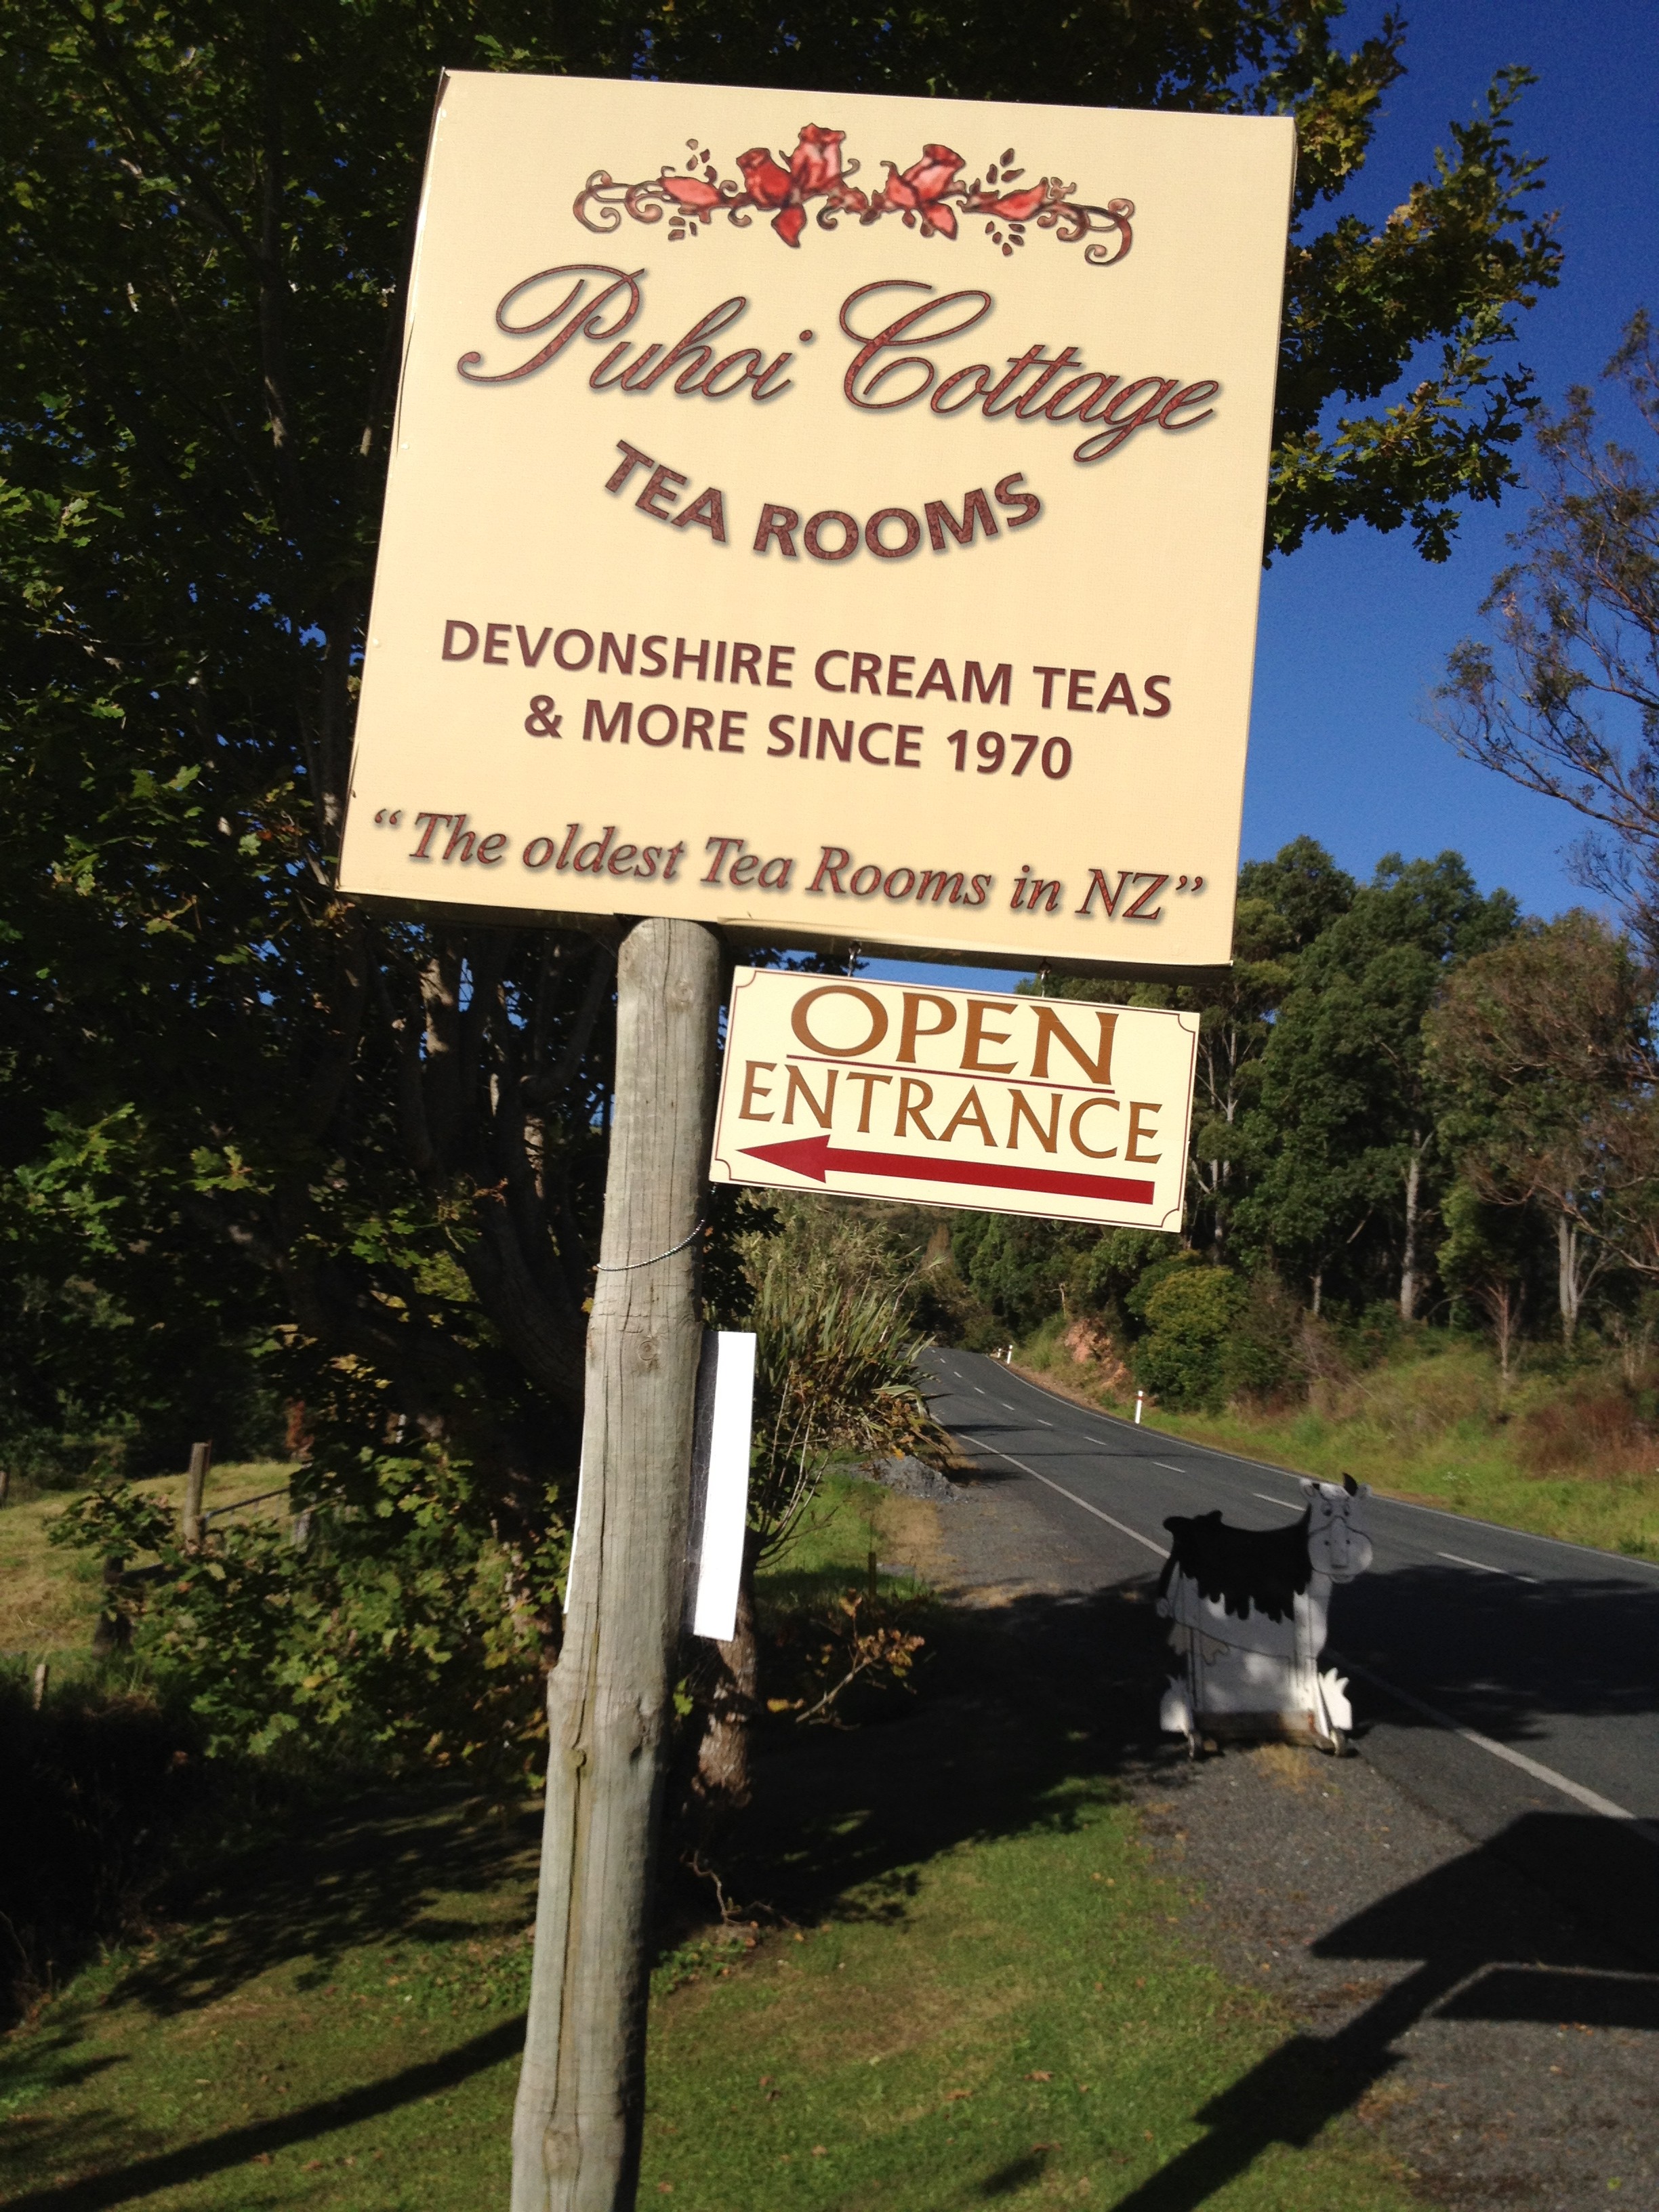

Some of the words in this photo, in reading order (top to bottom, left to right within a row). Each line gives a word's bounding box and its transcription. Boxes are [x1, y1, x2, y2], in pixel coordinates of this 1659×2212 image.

[456, 263, 814, 403] Puhoi
[838, 279, 1221, 464] Cottage
[604, 438, 727, 544] TEA
[752, 471, 1042, 562] ROOMS
[441, 619, 796, 689] DEVONSHIRE
[814, 649, 1013, 706] CREAM
[1031, 665, 1172, 718] TEAS
[524, 694, 563, 739] &
[581, 698, 748, 754] MORE
[766, 714, 924, 769] SINCE
[946, 729, 1073, 781] 1970
[522, 822, 685, 881] oldest
[699, 836, 794, 890] Tea
[804, 845, 993, 907] Rooms
[1009, 864, 1062, 913] in
[790, 984, 1119, 1086] OPEN
[737, 1059, 1162, 1164] ENTRANCE
